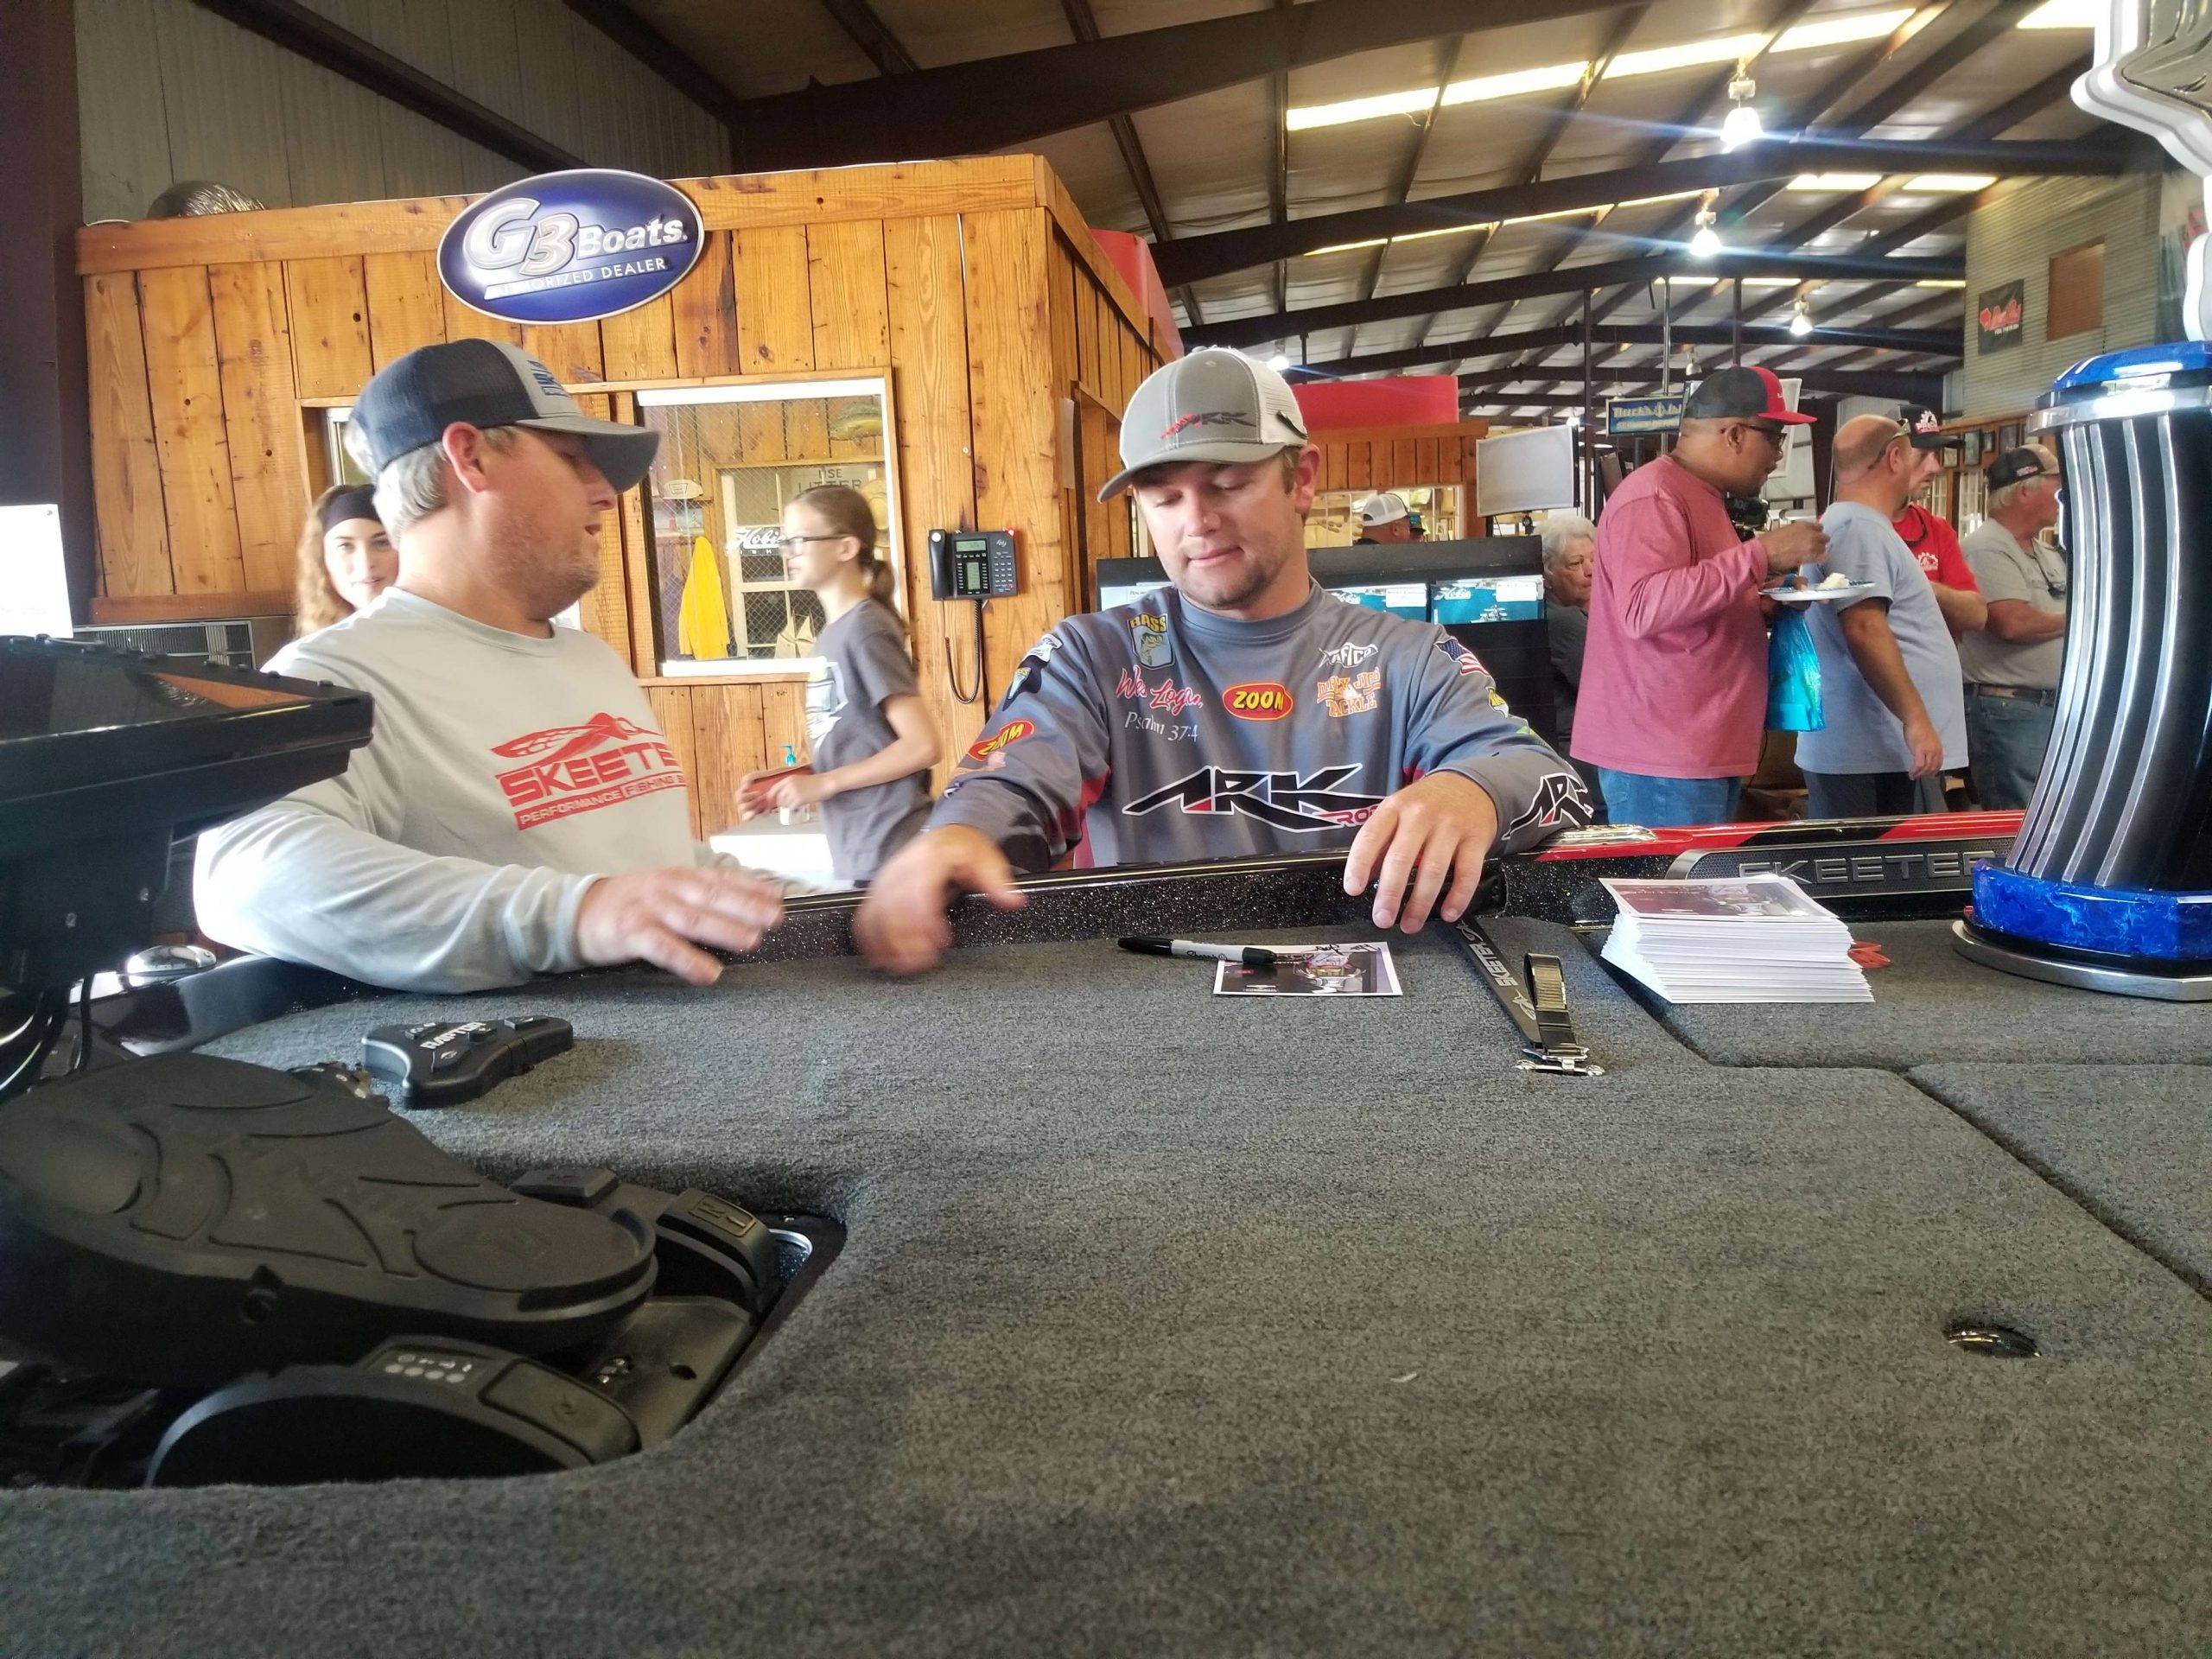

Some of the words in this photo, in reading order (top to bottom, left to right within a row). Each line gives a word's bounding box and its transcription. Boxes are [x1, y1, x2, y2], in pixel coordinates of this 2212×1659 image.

[462, 197, 579, 276] G3
[489, 270, 594, 297] UHORIZED
[601, 257, 667, 280] DEALER
[818, 468, 842, 479] USE
[728, 527, 787, 550] Hobie
[1130, 613, 1166, 632] BASS
[1116, 664, 1147, 699] Wes
[1232, 690, 1284, 711] ZOOM
[1124, 712, 1166, 735] Psalm
[1167, 725, 1198, 743] 37:4
[520, 791, 623, 825] PERFORMANCE
[625, 774, 675, 797] FISHING
[1122, 763, 1385, 833] ARK
[1469, 942, 1518, 987] SKEETER
[420, 1021, 487, 1050] RAPTOR
